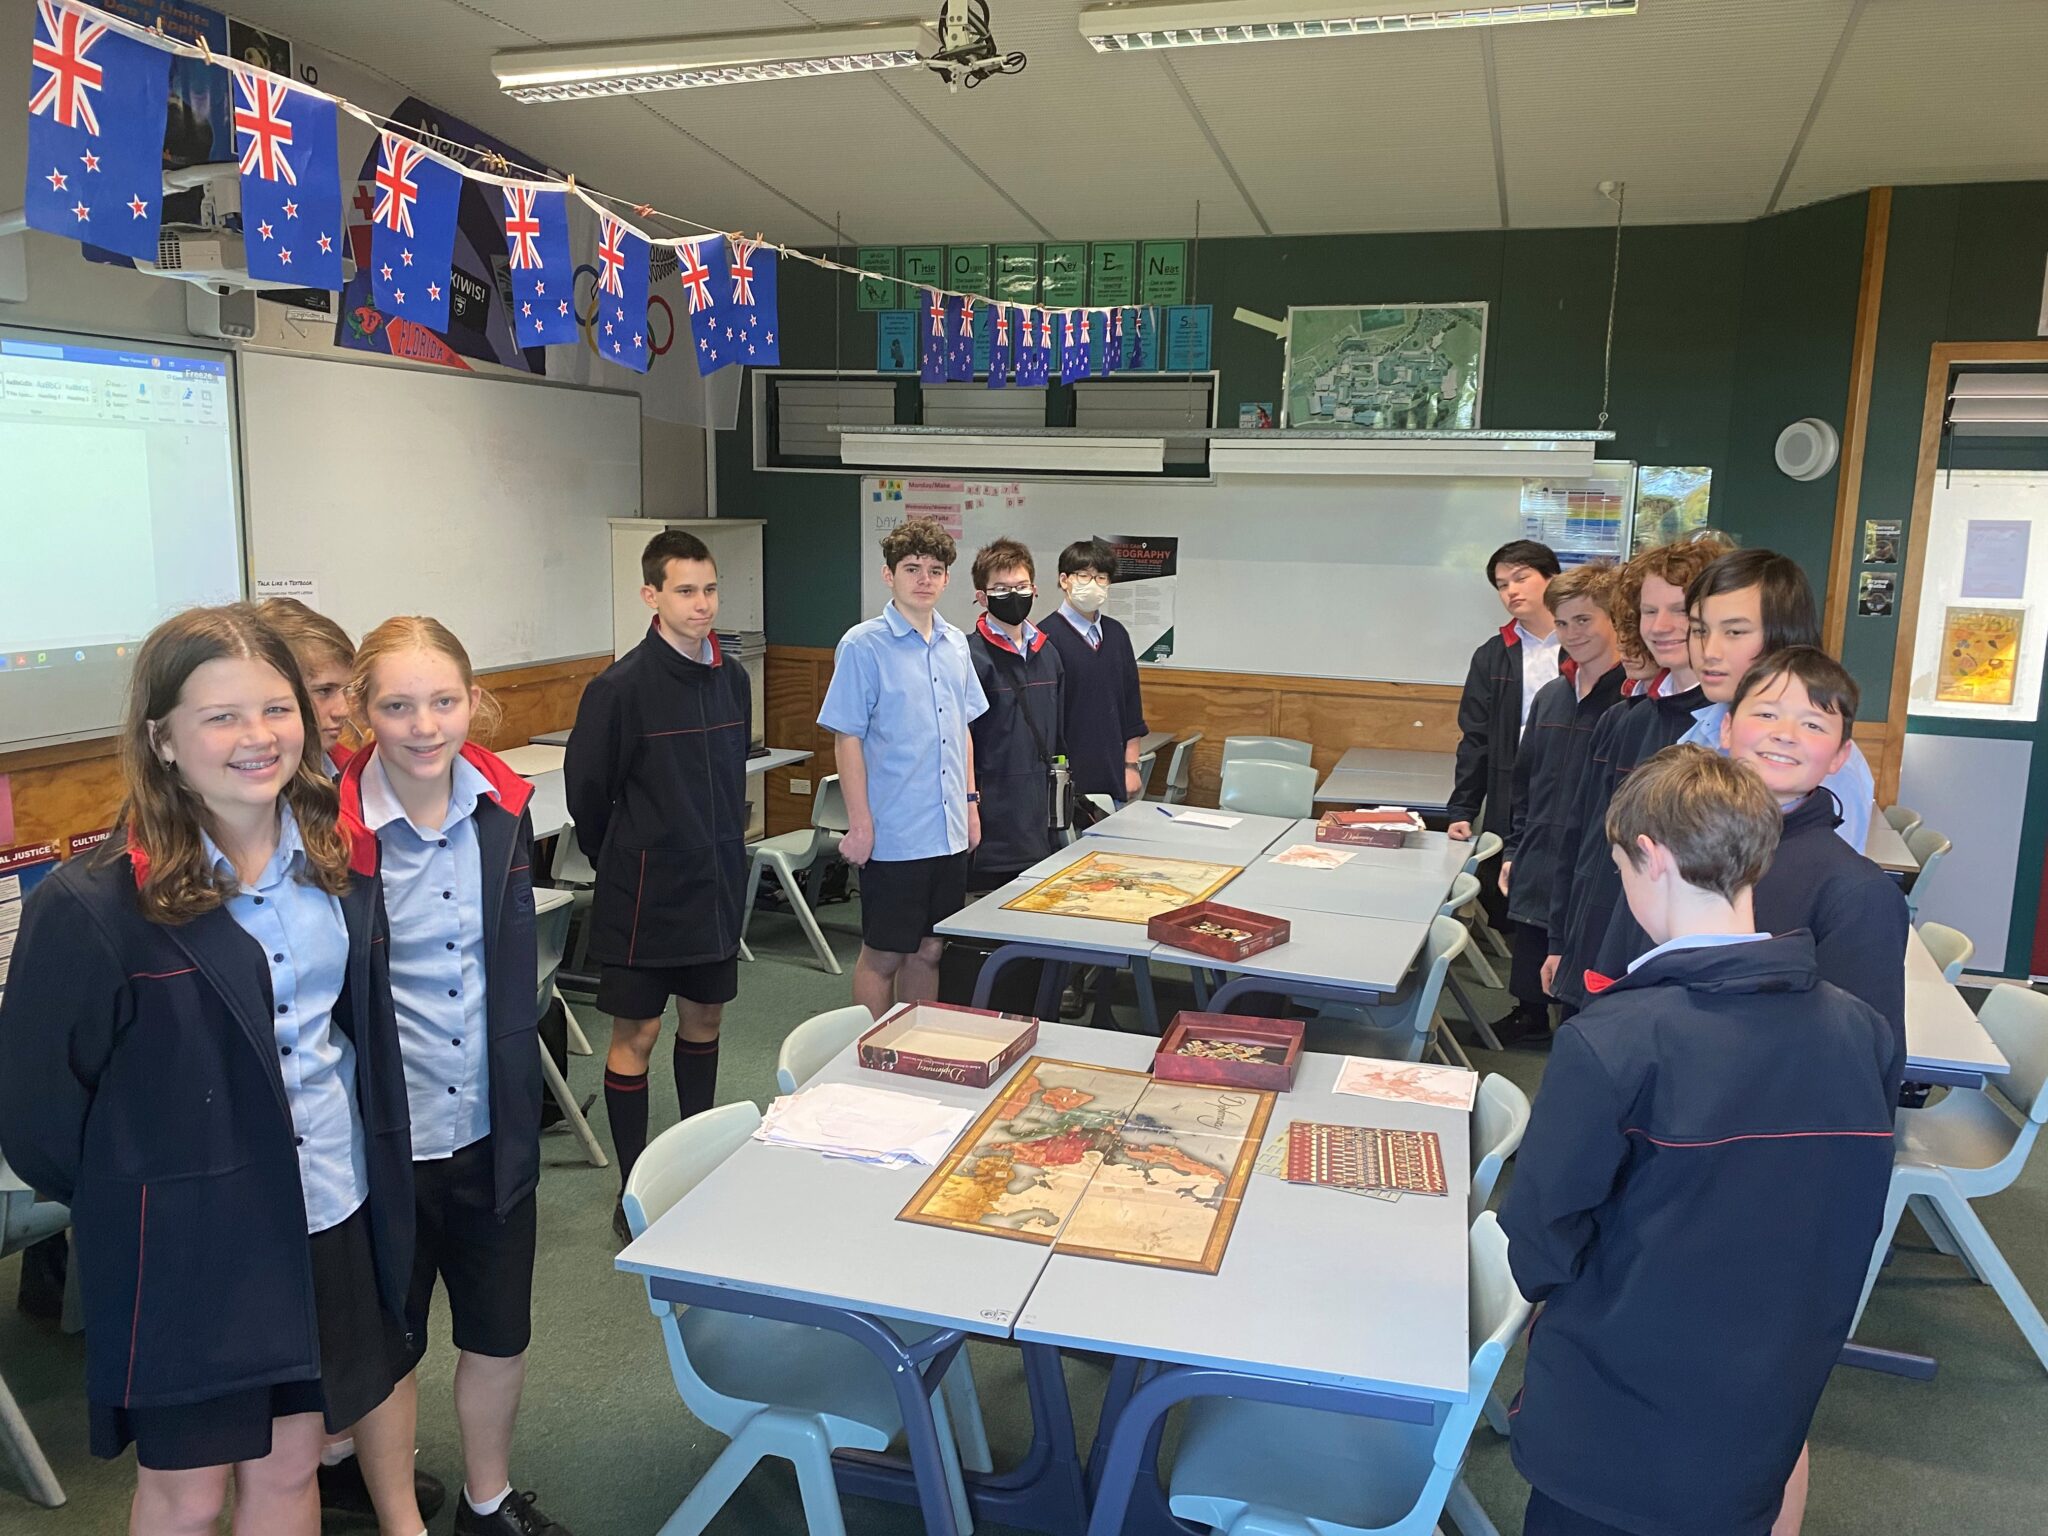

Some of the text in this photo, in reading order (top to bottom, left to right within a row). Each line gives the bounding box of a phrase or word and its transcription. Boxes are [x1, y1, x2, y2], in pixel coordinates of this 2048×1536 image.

[908, 258, 936, 275] Title
[1149, 256, 1180, 275] Neat
[399, 319, 444, 360] FLORIDA
[185, 369, 213, 379] Freeze
[72, 831, 111, 848] CULTURA
[12, 846, 52, 862] JUSTICE
[916, 1059, 966, 1083] Diplomacy
[1196, 1093, 1247, 1131] Diplomacy
